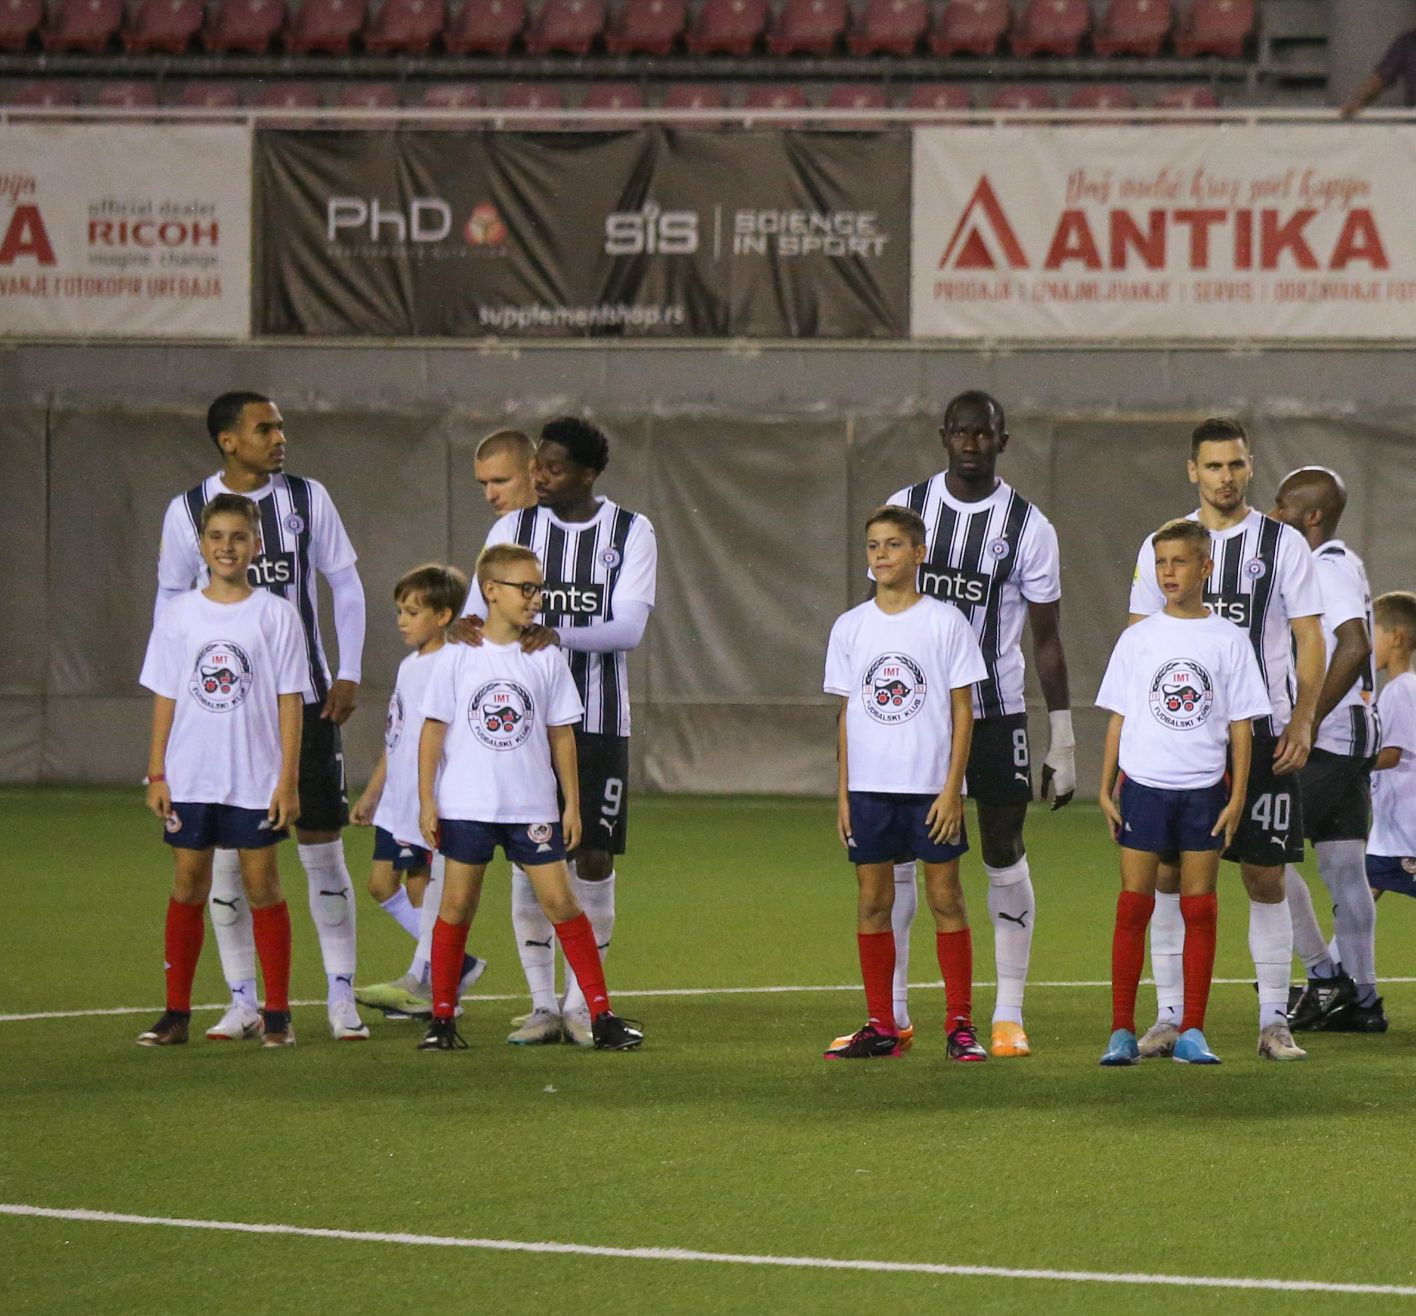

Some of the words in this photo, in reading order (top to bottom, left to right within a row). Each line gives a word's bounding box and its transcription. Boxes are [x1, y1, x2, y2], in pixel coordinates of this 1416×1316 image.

[327, 198, 452, 241] PhD
[734, 209, 880, 234] SCIENCE
[88, 218, 220, 247] RICOH
[1044, 209, 1389, 270] ANTIKA
[734, 235, 768, 256] IN
[778, 235, 889, 257] SPORT
[479, 303, 686, 328] supplementshop.rs
[923, 572, 983, 601] mts
[1202, 597, 1245, 623] ts
[212, 655, 228, 664] IMT
[883, 667, 900, 677] IMT
[1173, 673, 1189, 682] IMT
[494, 694, 510, 703] IMT
[904, 698, 921, 717] KLUB
[1154, 706, 1194, 727] FUDBALSKI
[1013, 728, 1029, 767] 8
[601, 778, 623, 816] 9
[1251, 793, 1290, 830] 40
